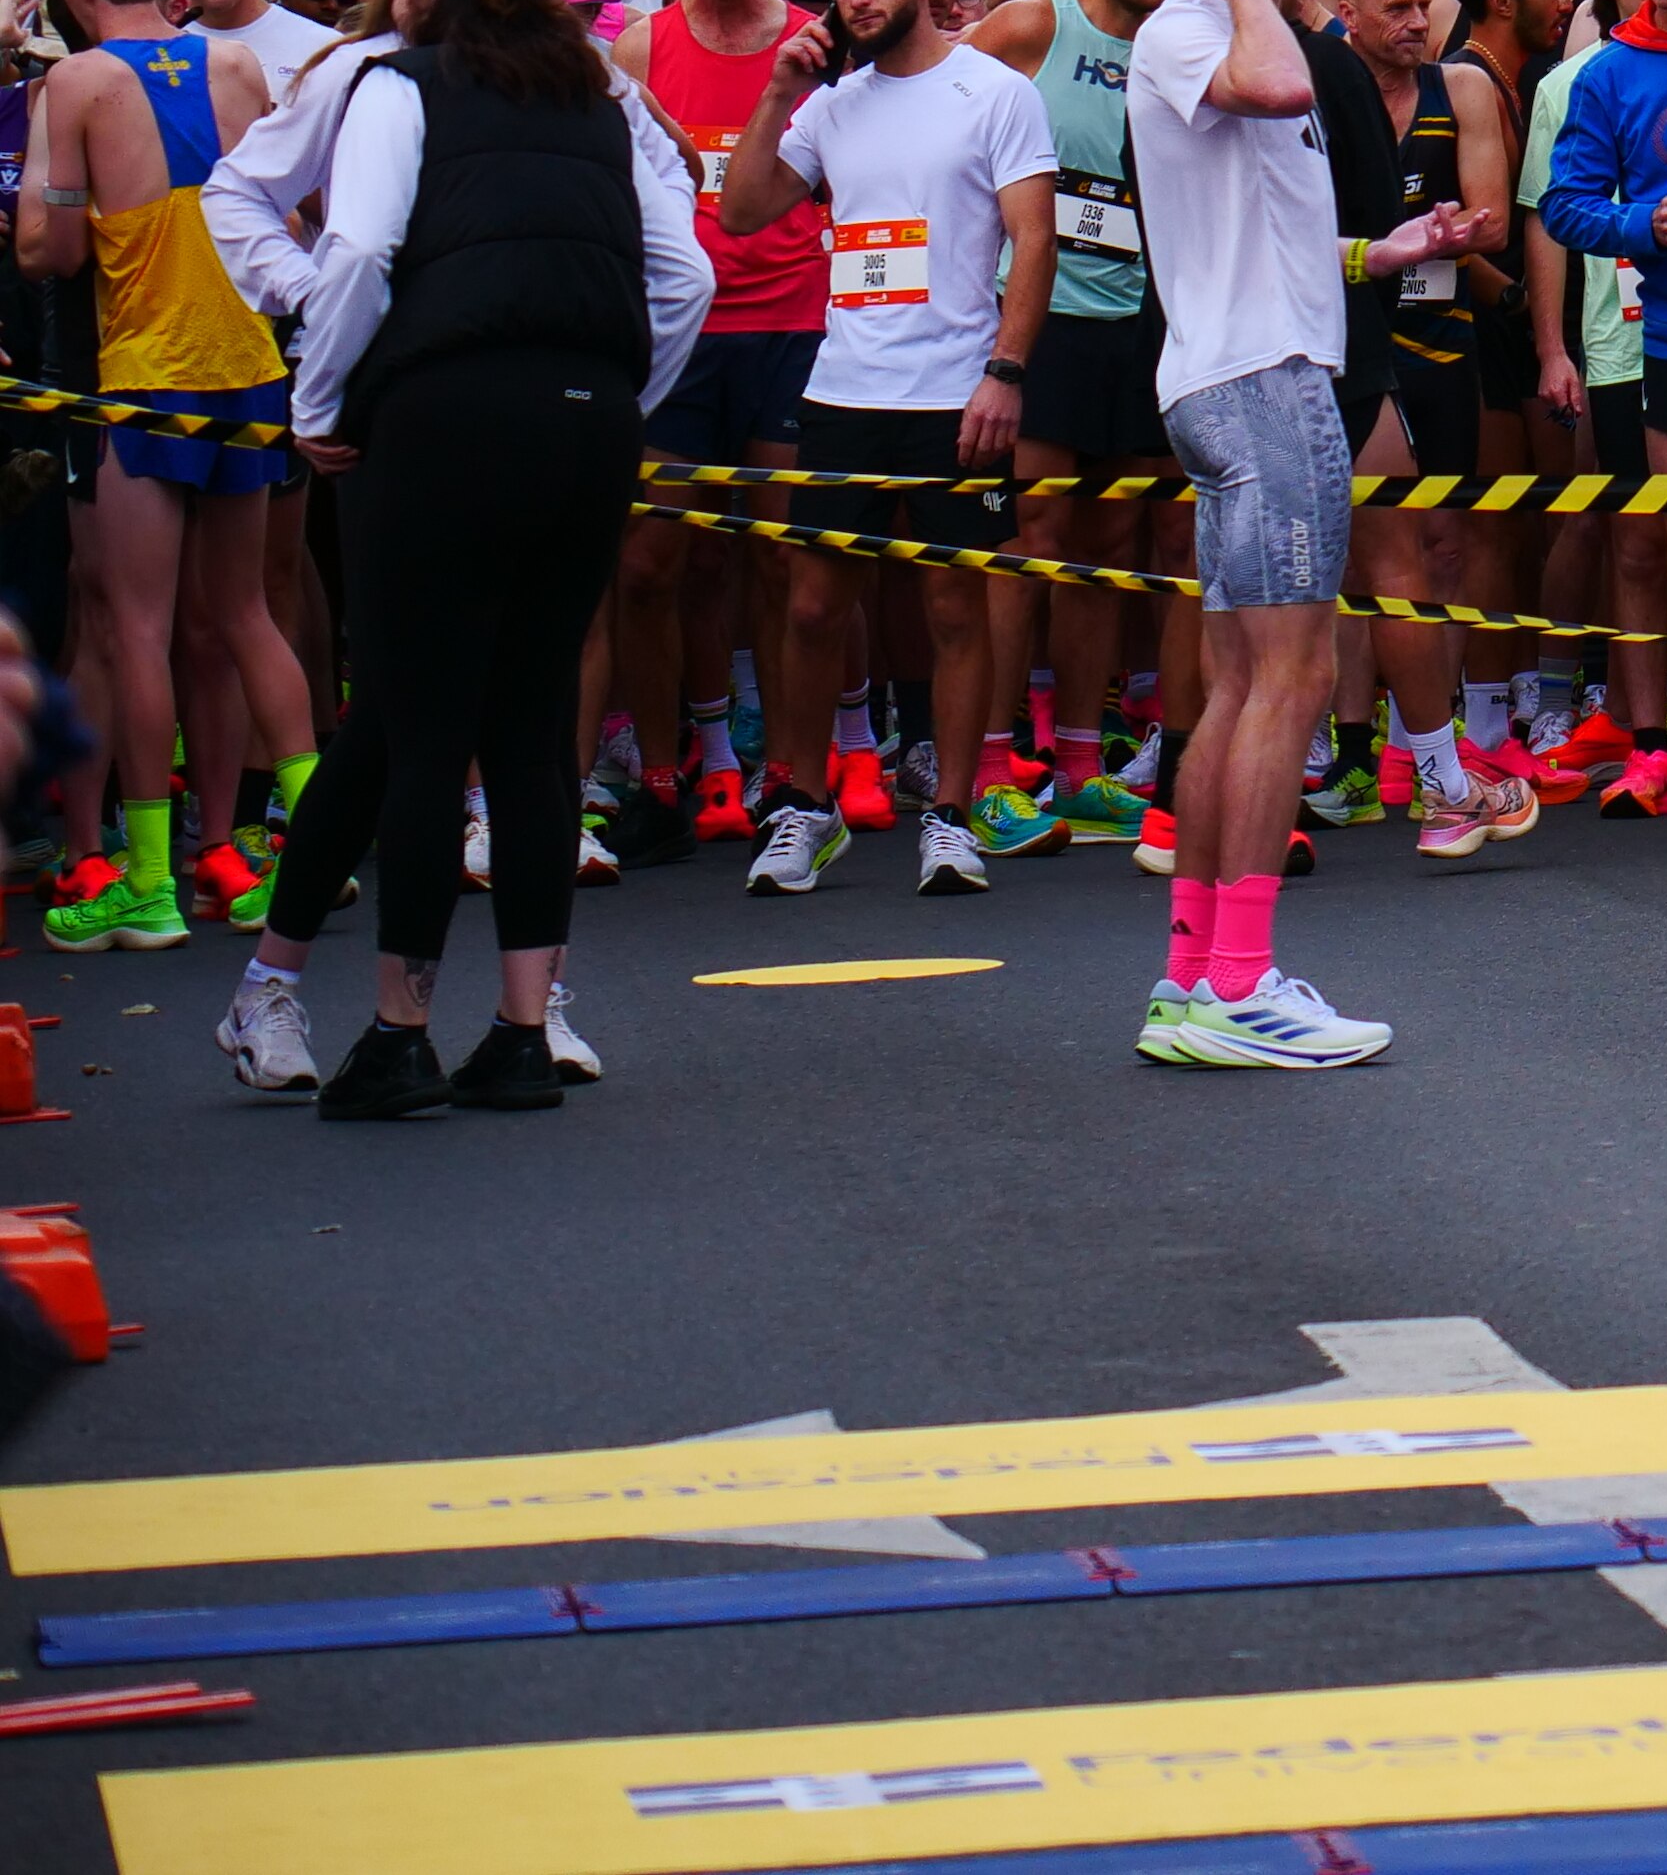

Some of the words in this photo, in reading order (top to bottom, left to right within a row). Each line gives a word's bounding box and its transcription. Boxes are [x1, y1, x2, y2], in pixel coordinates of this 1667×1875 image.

[1081, 202, 1105, 221] 1336
[1077, 219, 1103, 238] DION
[863, 254, 887, 270] 3005
[863, 271, 886, 287] PAIN
[1290, 517, 1309, 588] ADIZERO
